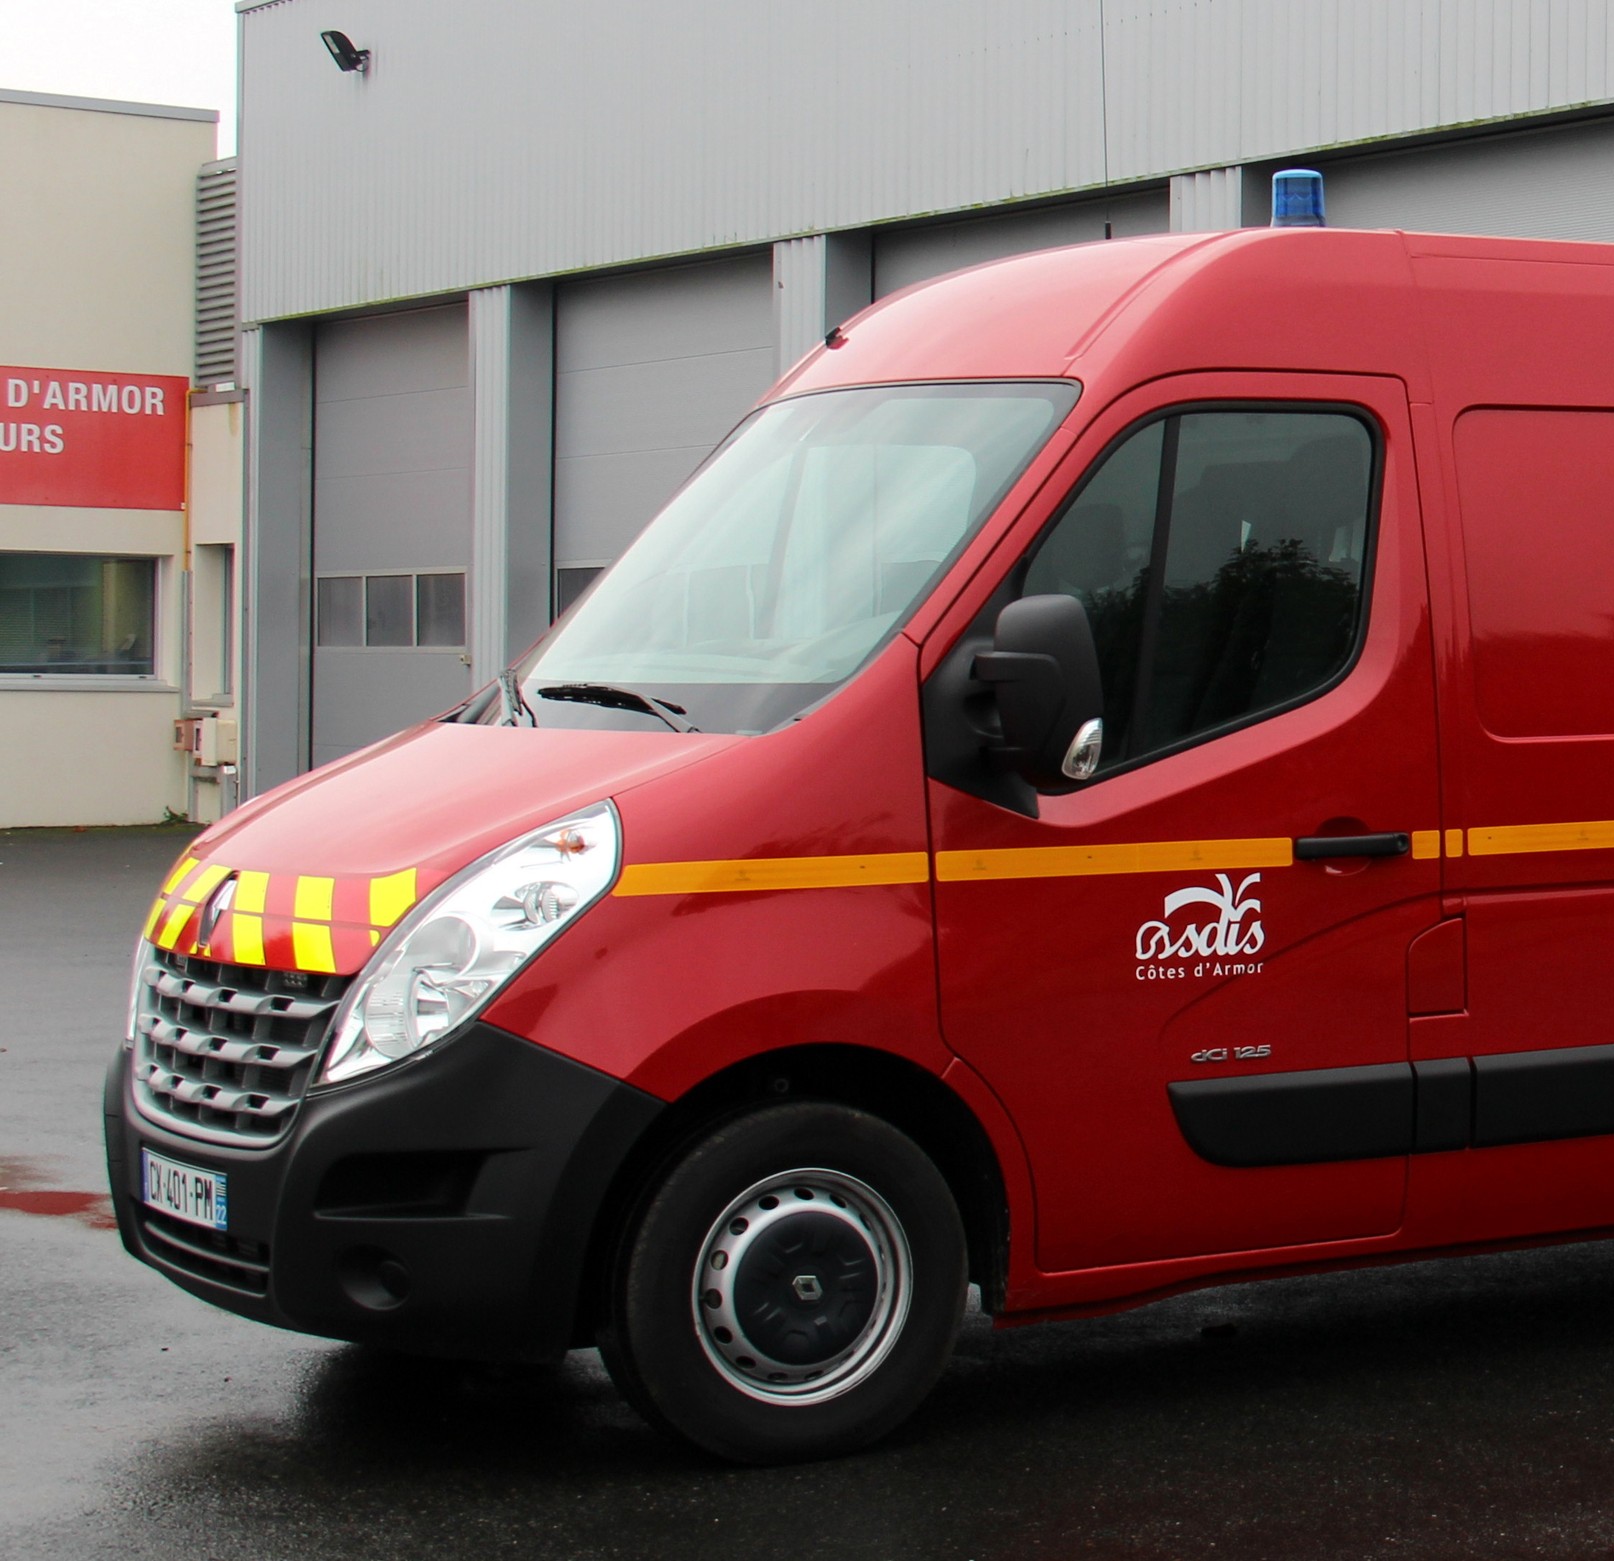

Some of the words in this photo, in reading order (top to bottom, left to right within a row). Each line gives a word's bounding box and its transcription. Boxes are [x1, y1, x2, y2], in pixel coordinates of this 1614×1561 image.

[7, 378, 165, 416] D'ARMOR
[1135, 964, 1186, 981] Côtes
[1193, 961, 1265, 978] d'Armor
[1233, 1044, 1272, 1060] 125
